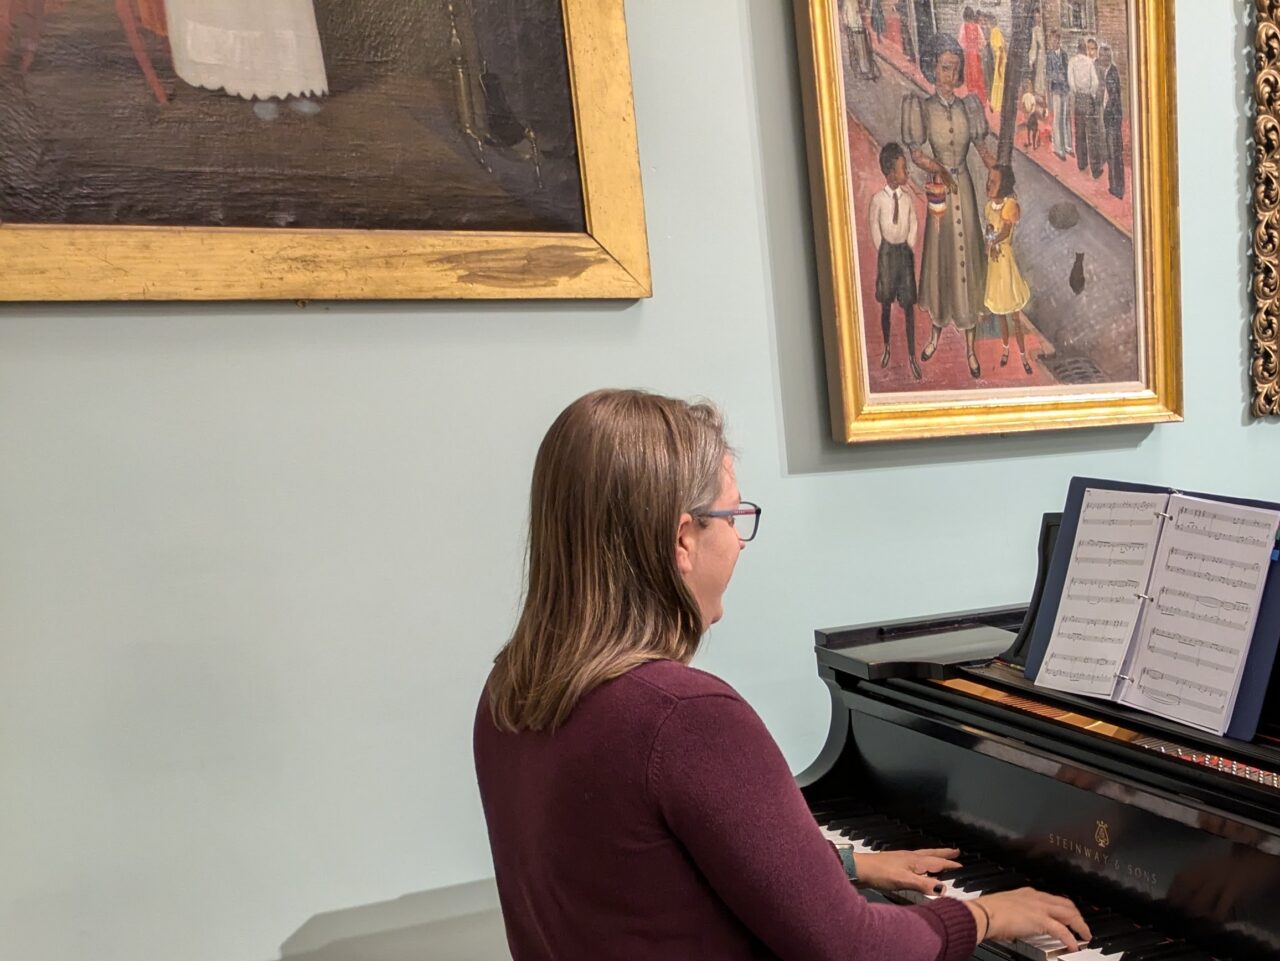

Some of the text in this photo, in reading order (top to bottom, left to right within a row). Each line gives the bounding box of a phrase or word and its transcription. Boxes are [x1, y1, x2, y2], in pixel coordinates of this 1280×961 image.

[1049, 833, 1157, 885] STEINWAY & SONS
